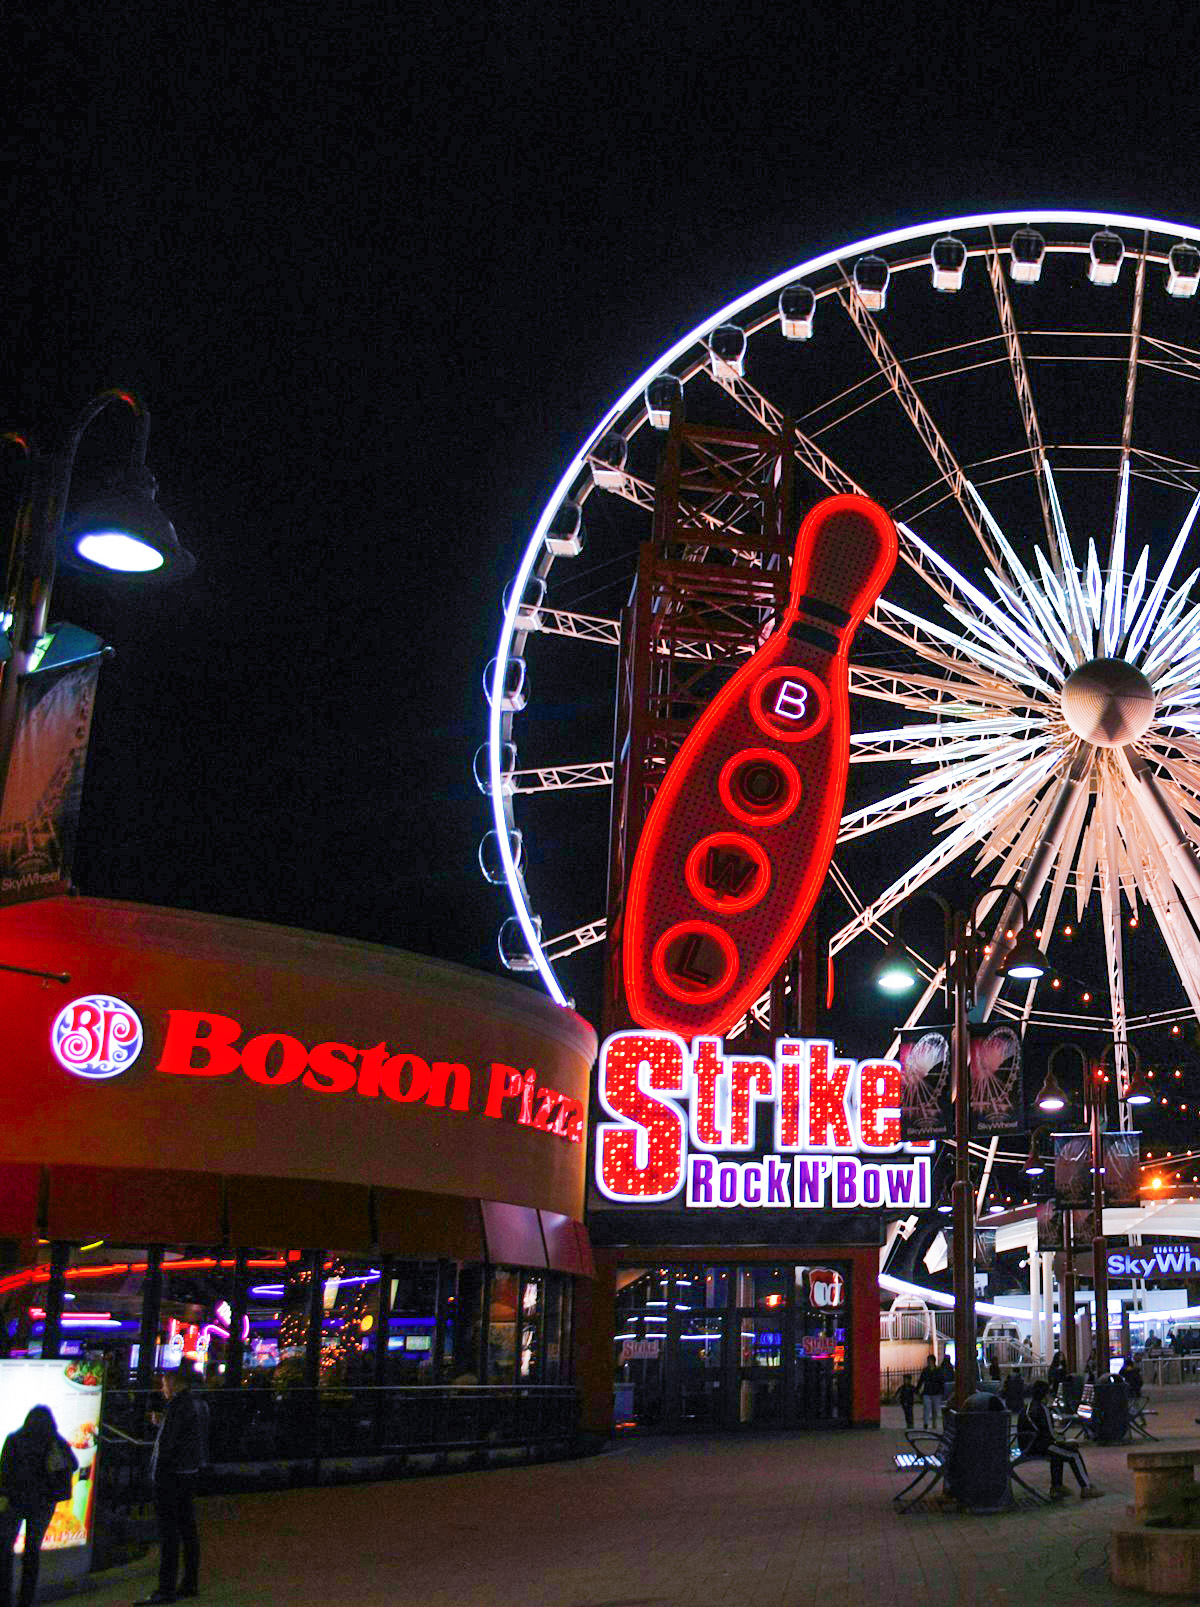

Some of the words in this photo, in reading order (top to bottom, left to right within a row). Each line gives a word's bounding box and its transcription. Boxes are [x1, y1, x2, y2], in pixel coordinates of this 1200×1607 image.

[157, 1009, 472, 1112] Boston
[484, 1063, 584, 1144] Pizza
[687, 1155, 791, 1207] Rock
